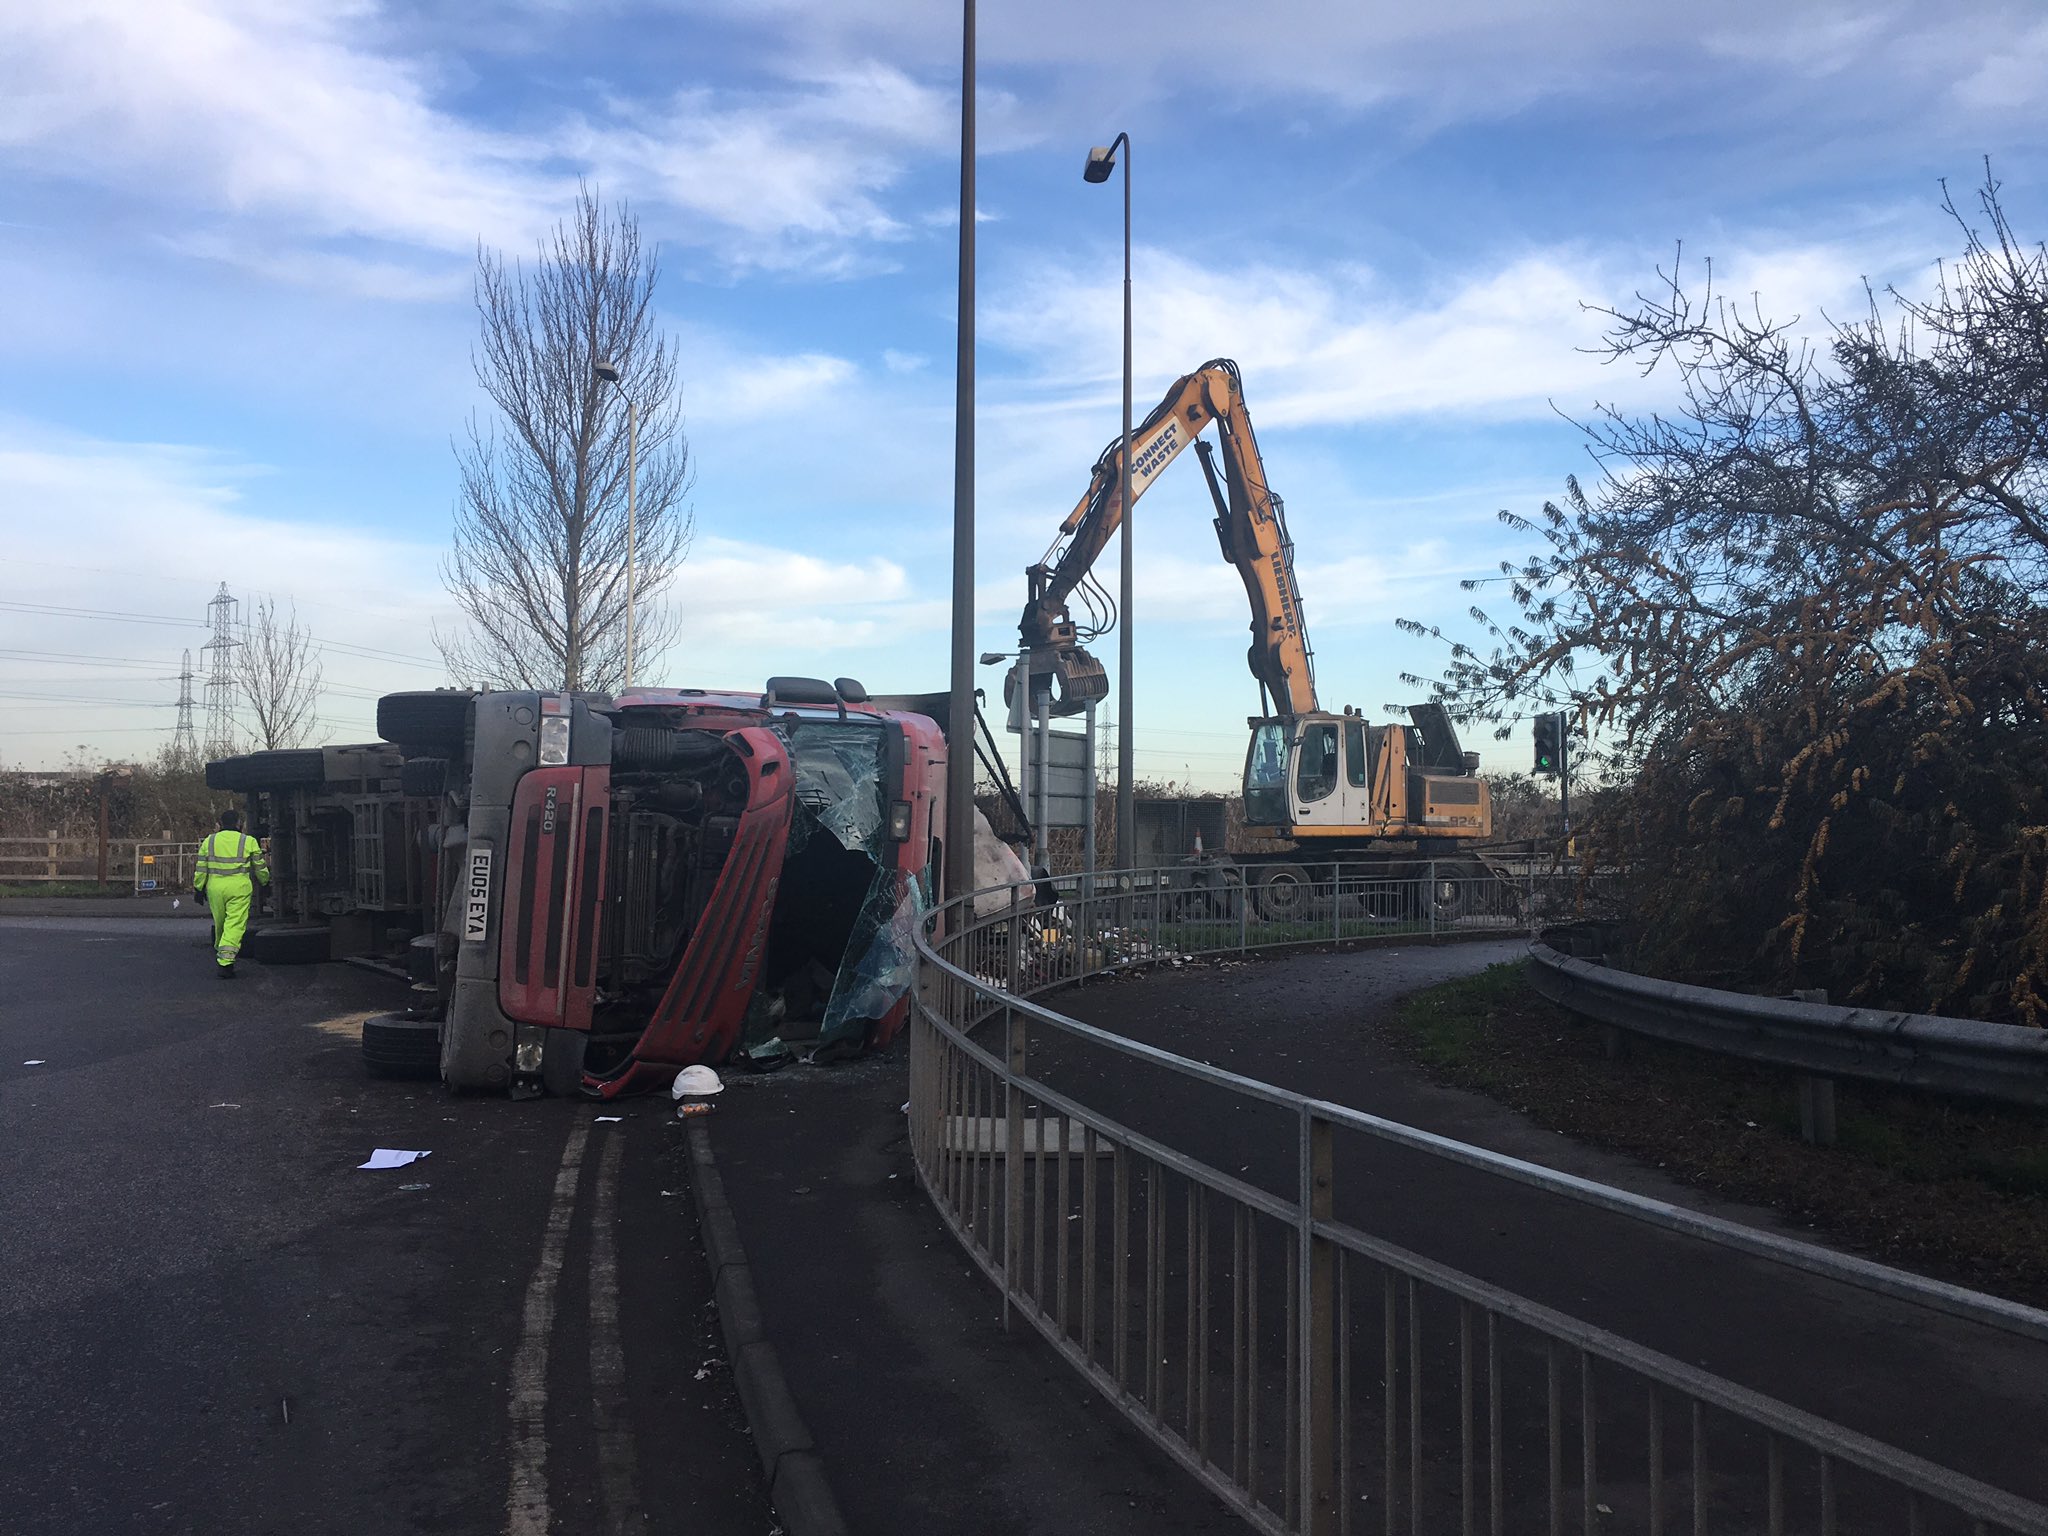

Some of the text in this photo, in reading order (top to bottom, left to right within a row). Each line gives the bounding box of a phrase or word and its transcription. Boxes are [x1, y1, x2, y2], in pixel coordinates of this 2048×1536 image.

[1130, 424, 1177, 474] CONNECT
[1141, 439, 1178, 477] WASTE
[1271, 552, 1296, 636] LIEBHERR
[468, 855, 489, 934] EU05 EYA
